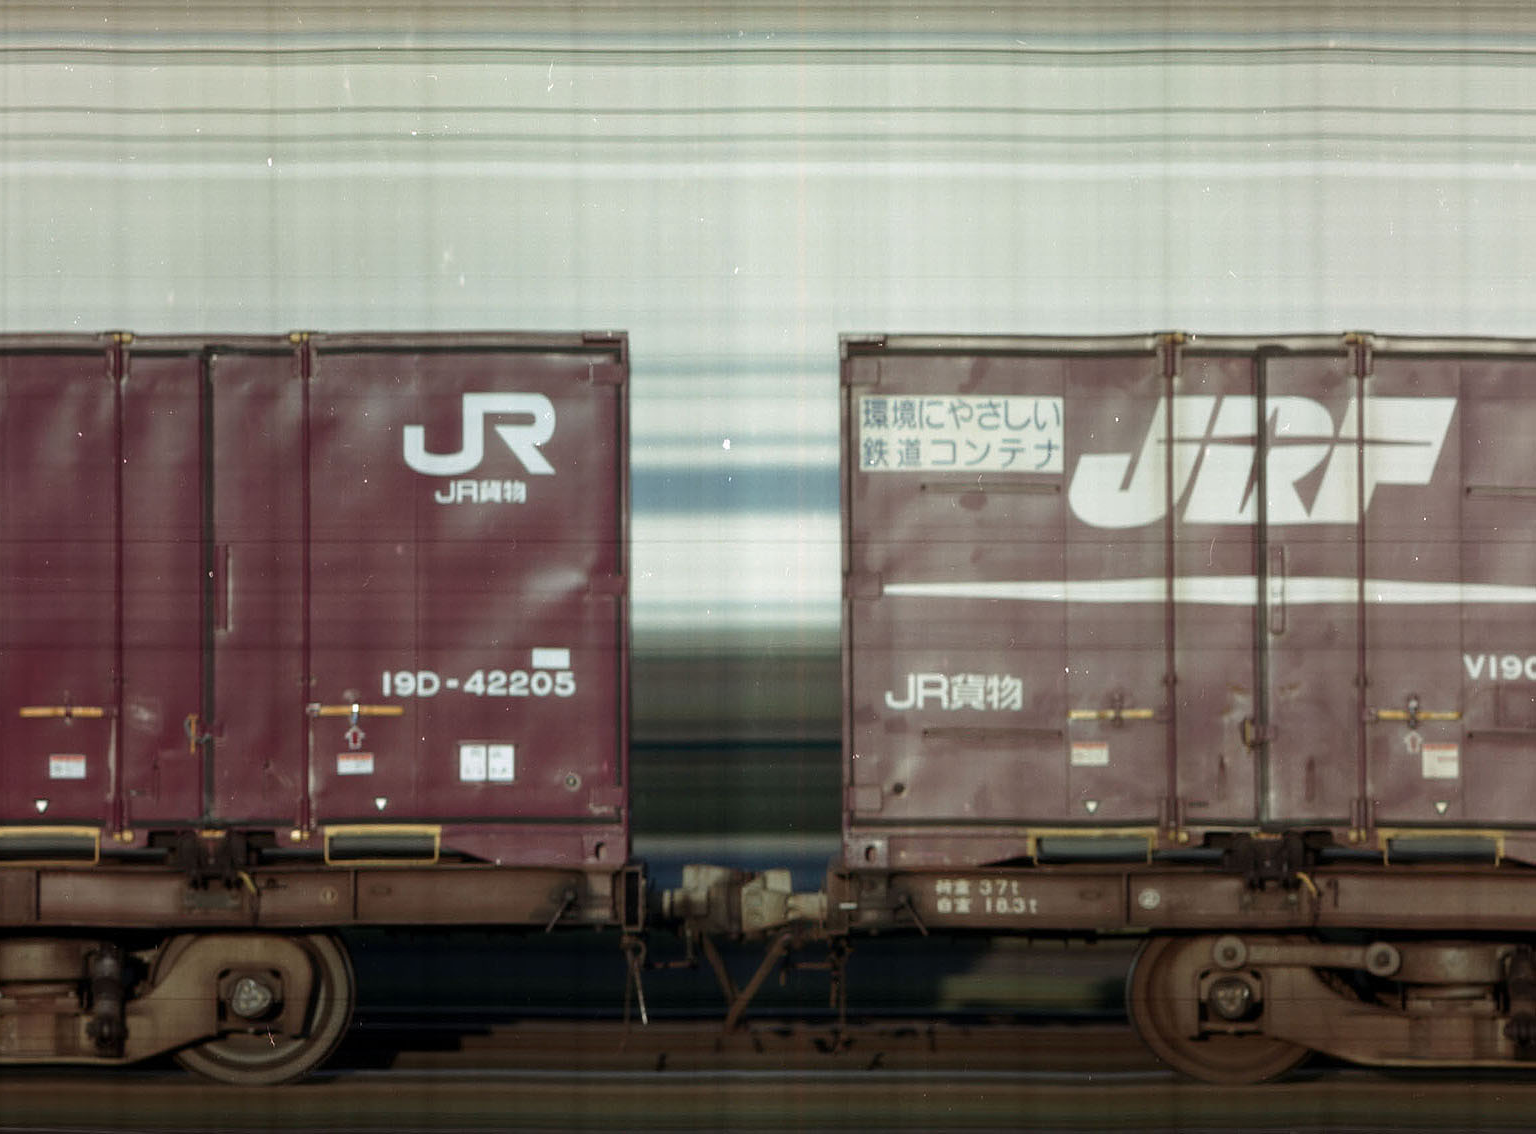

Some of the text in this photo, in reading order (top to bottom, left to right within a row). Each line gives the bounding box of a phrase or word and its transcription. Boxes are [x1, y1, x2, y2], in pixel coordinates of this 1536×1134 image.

[862, 399, 1060, 432] 環境にやさしい
[403, 392, 557, 476] JR
[862, 437, 1059, 470] 鉄道コンテナ
[1068, 396, 1457, 530] JRF
[382, 669, 576, 697] 19D-42205
[885, 673, 1023, 710] JR貨物
